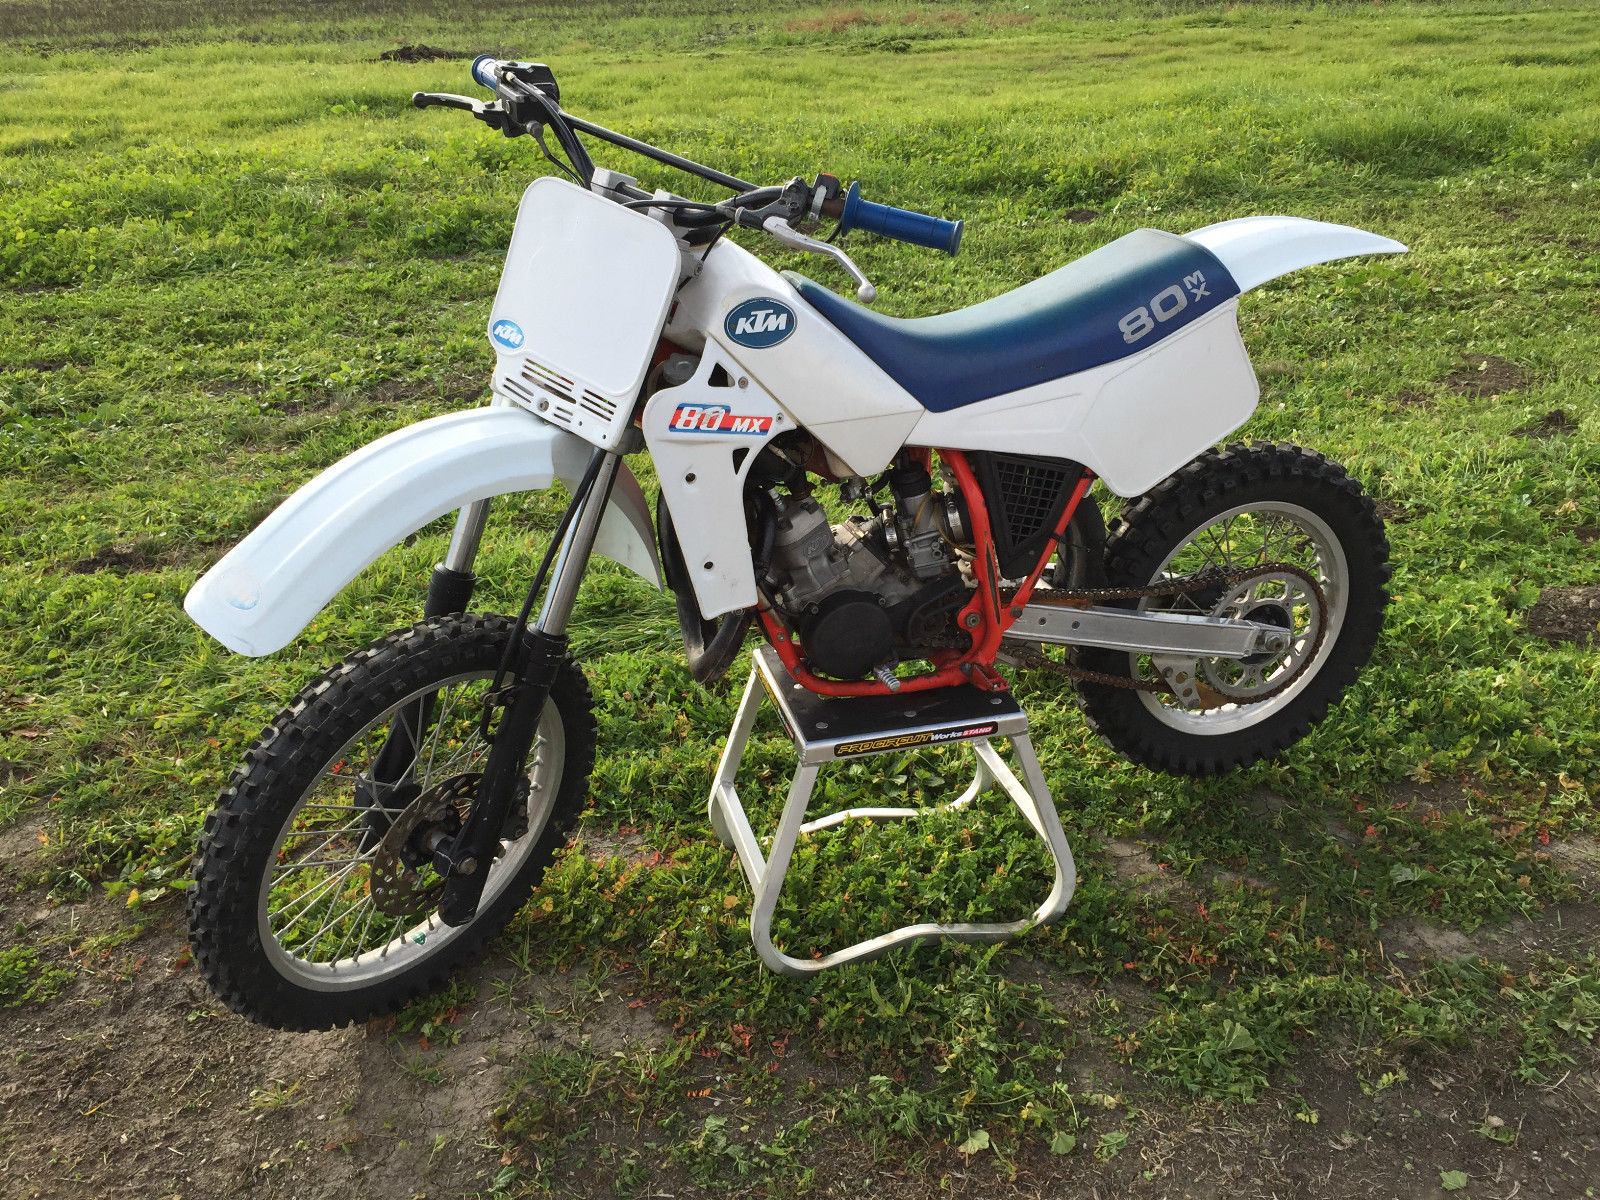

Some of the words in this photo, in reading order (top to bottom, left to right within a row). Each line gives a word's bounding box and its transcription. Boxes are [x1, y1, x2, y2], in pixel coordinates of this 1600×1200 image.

[735, 309, 788, 334] KTM
[1118, 284, 1188, 344] 80
[493, 324, 523, 345] KTM
[675, 406, 726, 431] 80
[730, 417, 765, 433] MX
